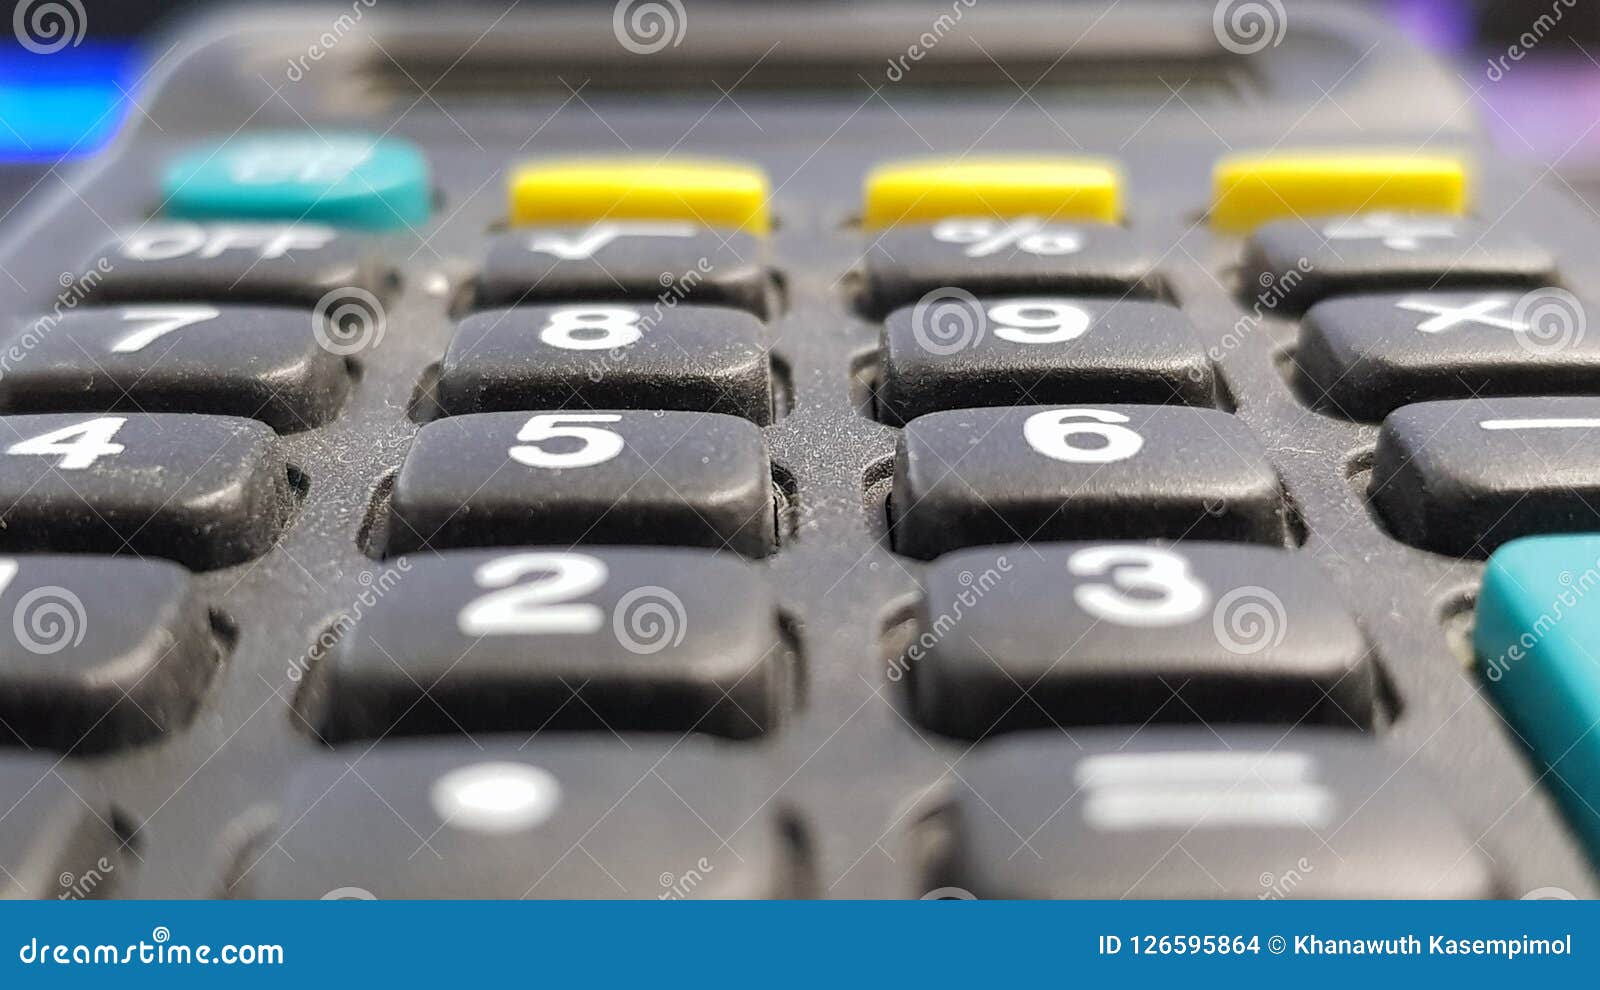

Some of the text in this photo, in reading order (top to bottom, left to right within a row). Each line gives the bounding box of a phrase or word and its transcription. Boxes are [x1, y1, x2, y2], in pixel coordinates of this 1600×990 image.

[119, 218, 336, 260] OFF
[112, 305, 221, 353] 7
[540, 304, 643, 350] 8
[987, 300, 1093, 344] 9
[6, 416, 128, 470] 4
[508, 413, 626, 469] 5
[1022, 408, 1145, 464] 6
[457, 551, 608, 635] 2
[1067, 545, 1210, 627] 3
